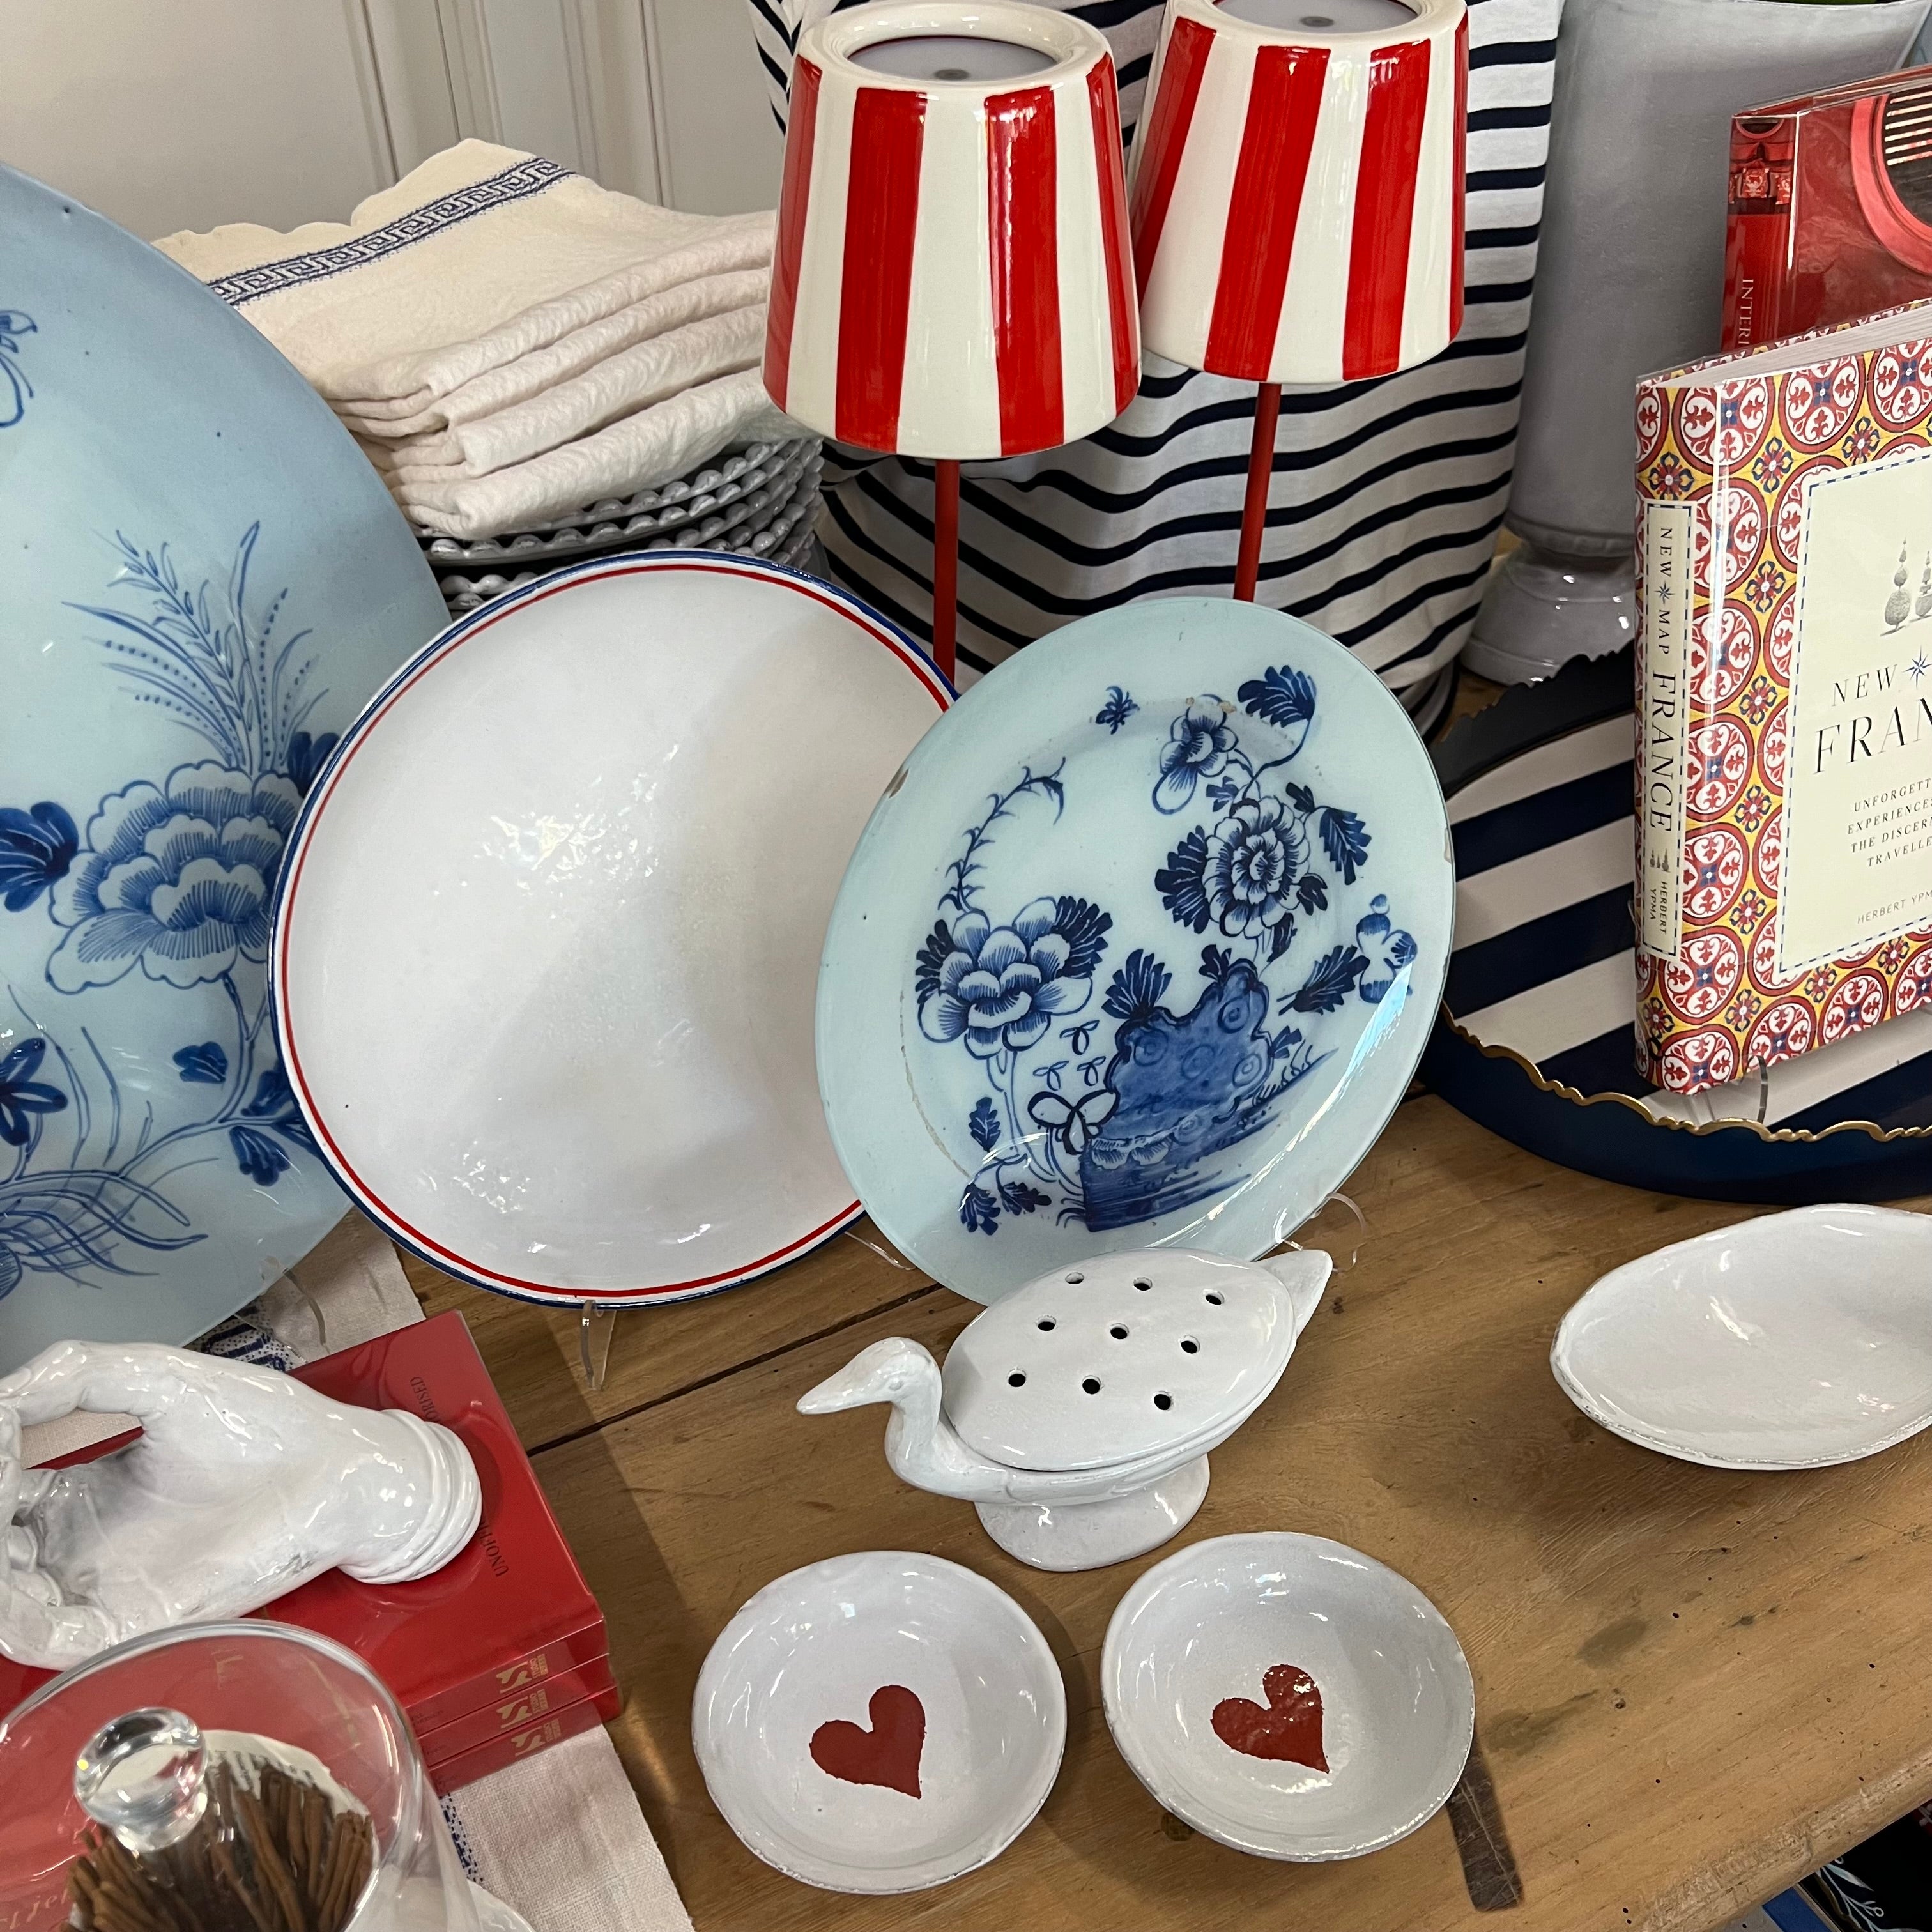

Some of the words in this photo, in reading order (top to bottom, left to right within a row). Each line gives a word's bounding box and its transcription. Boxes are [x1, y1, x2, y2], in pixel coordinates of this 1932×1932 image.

[1660, 528, 1673, 577] NEW
[1659, 610, 1671, 655] MAP
[1831, 664, 1897, 707] NEW
[1650, 670, 1676, 832] FRANCE
[1854, 778, 1931, 812] UNFORGETT
[1848, 798, 1932, 834] EXPERIENCE
[1851, 836, 1875, 854] THE
[1867, 836, 1932, 867] TRAVELLE
[1659, 881, 1668, 935] HERBERT
[1857, 898, 1906, 924] HERBERT
